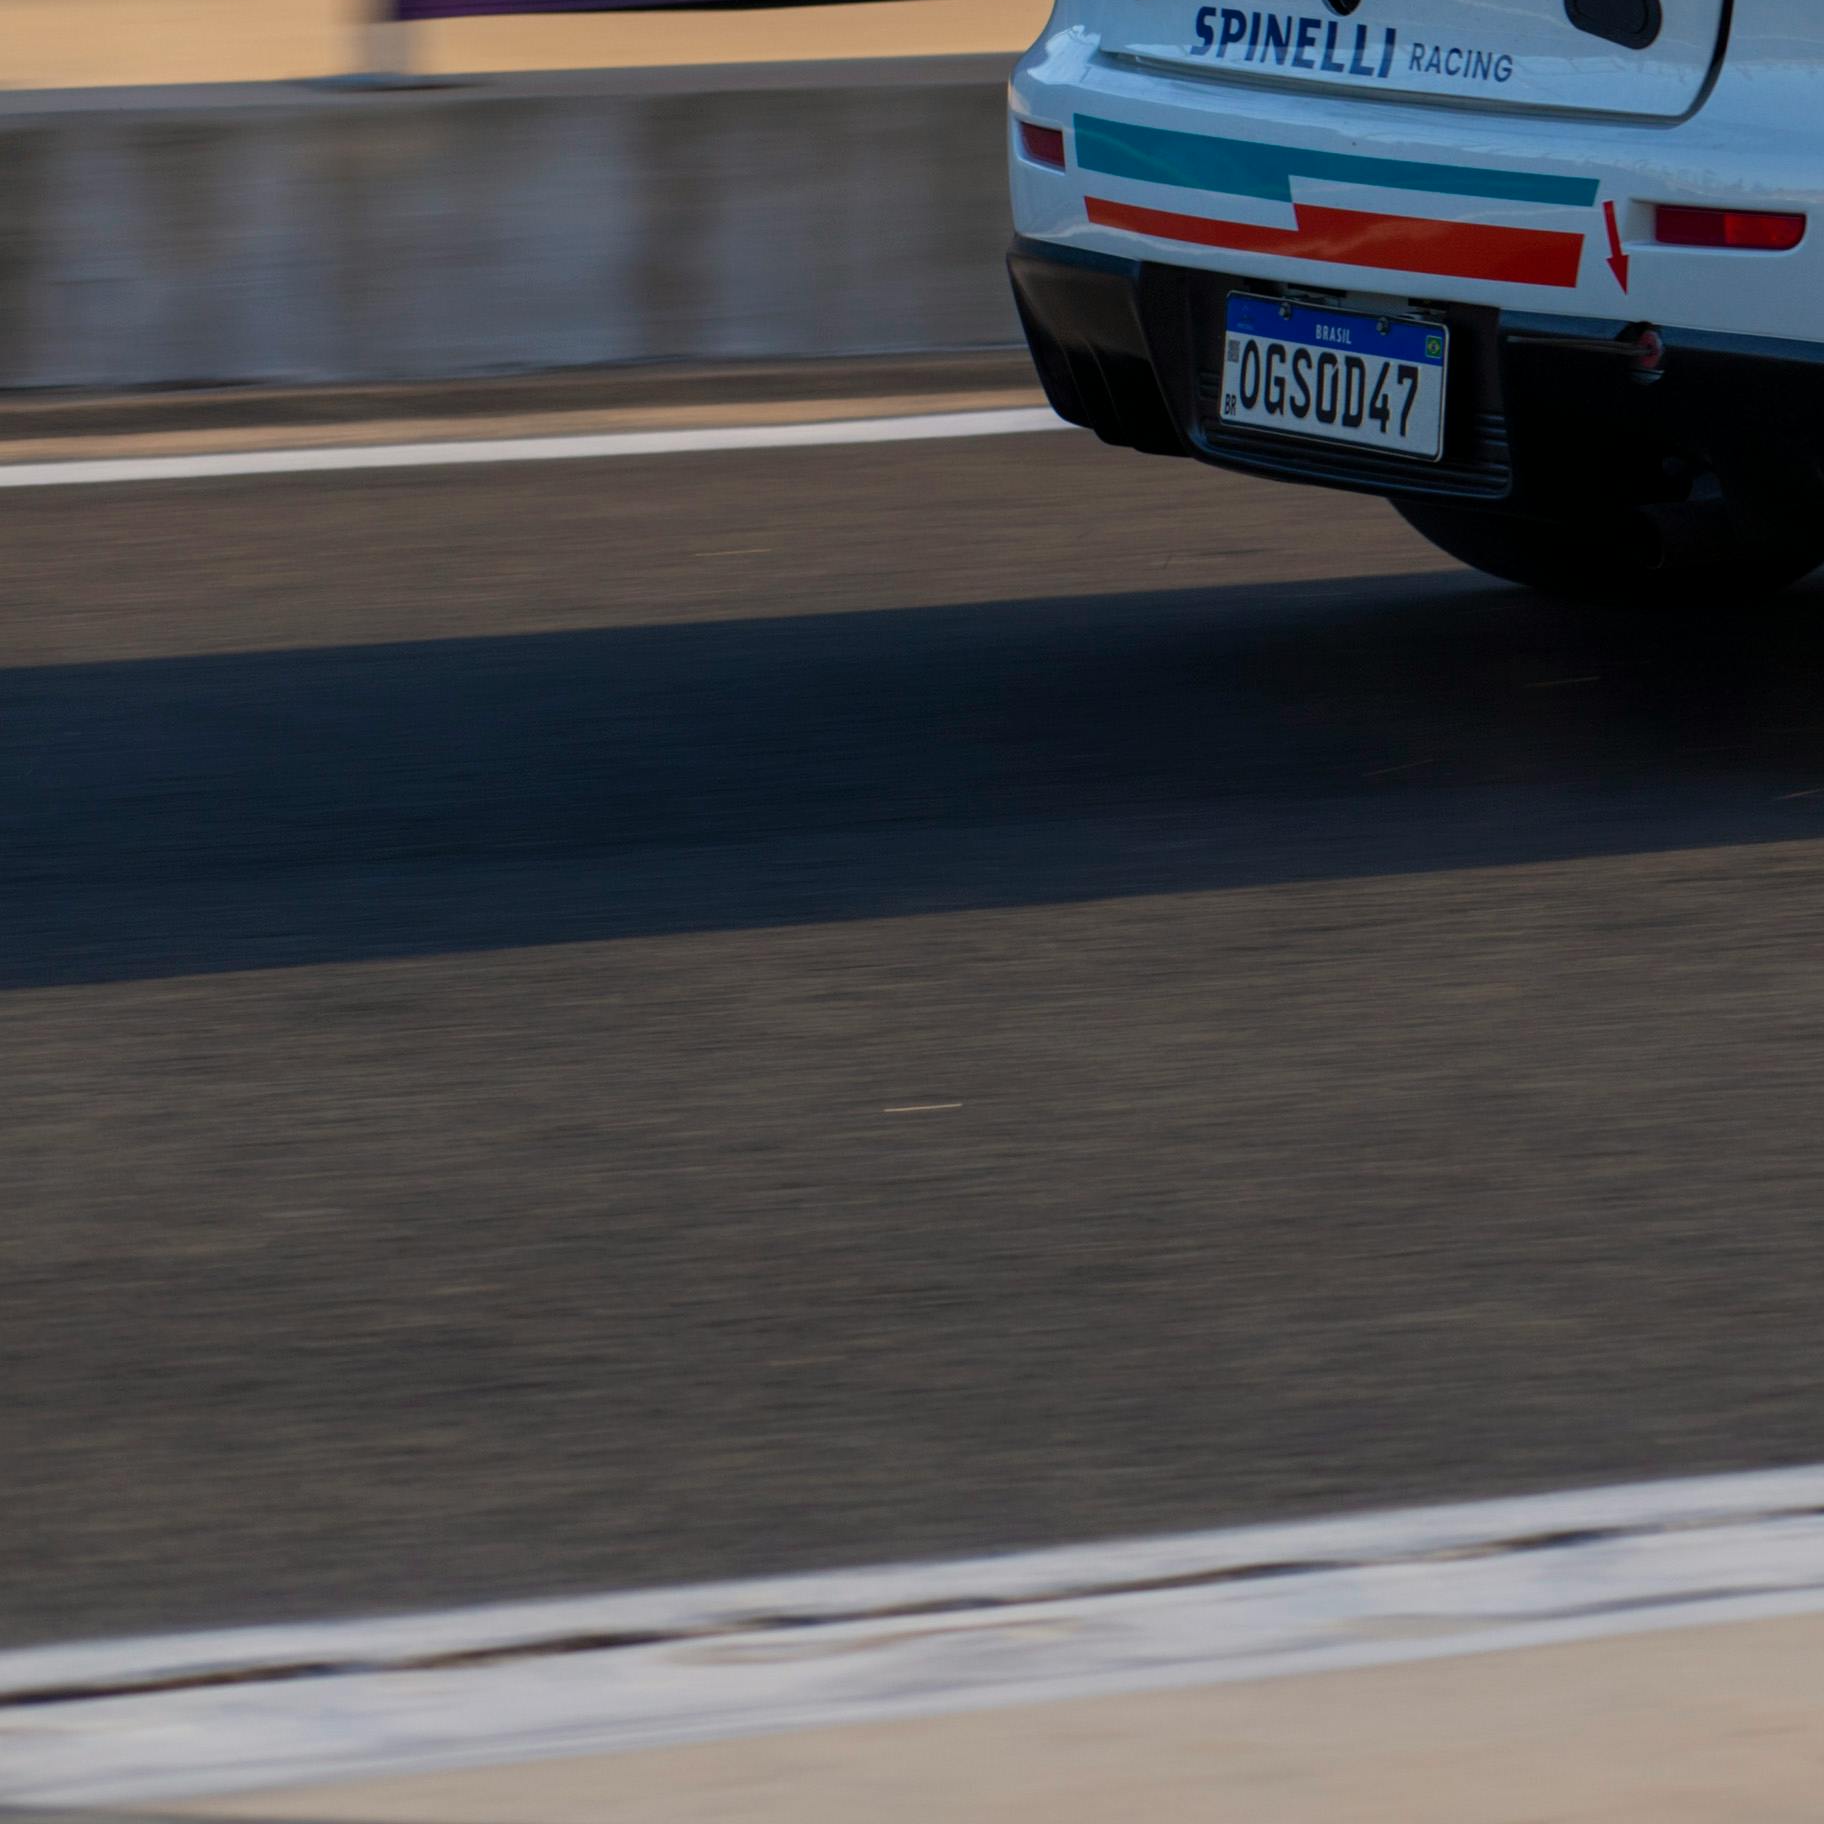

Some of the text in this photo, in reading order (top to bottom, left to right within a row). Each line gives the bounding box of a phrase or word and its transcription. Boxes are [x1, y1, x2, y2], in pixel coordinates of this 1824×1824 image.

[1190, 5, 1514, 83] SPINELLI RACING
[1315, 324, 1352, 345] BRASIL
[1224, 393, 1237, 416] BR
